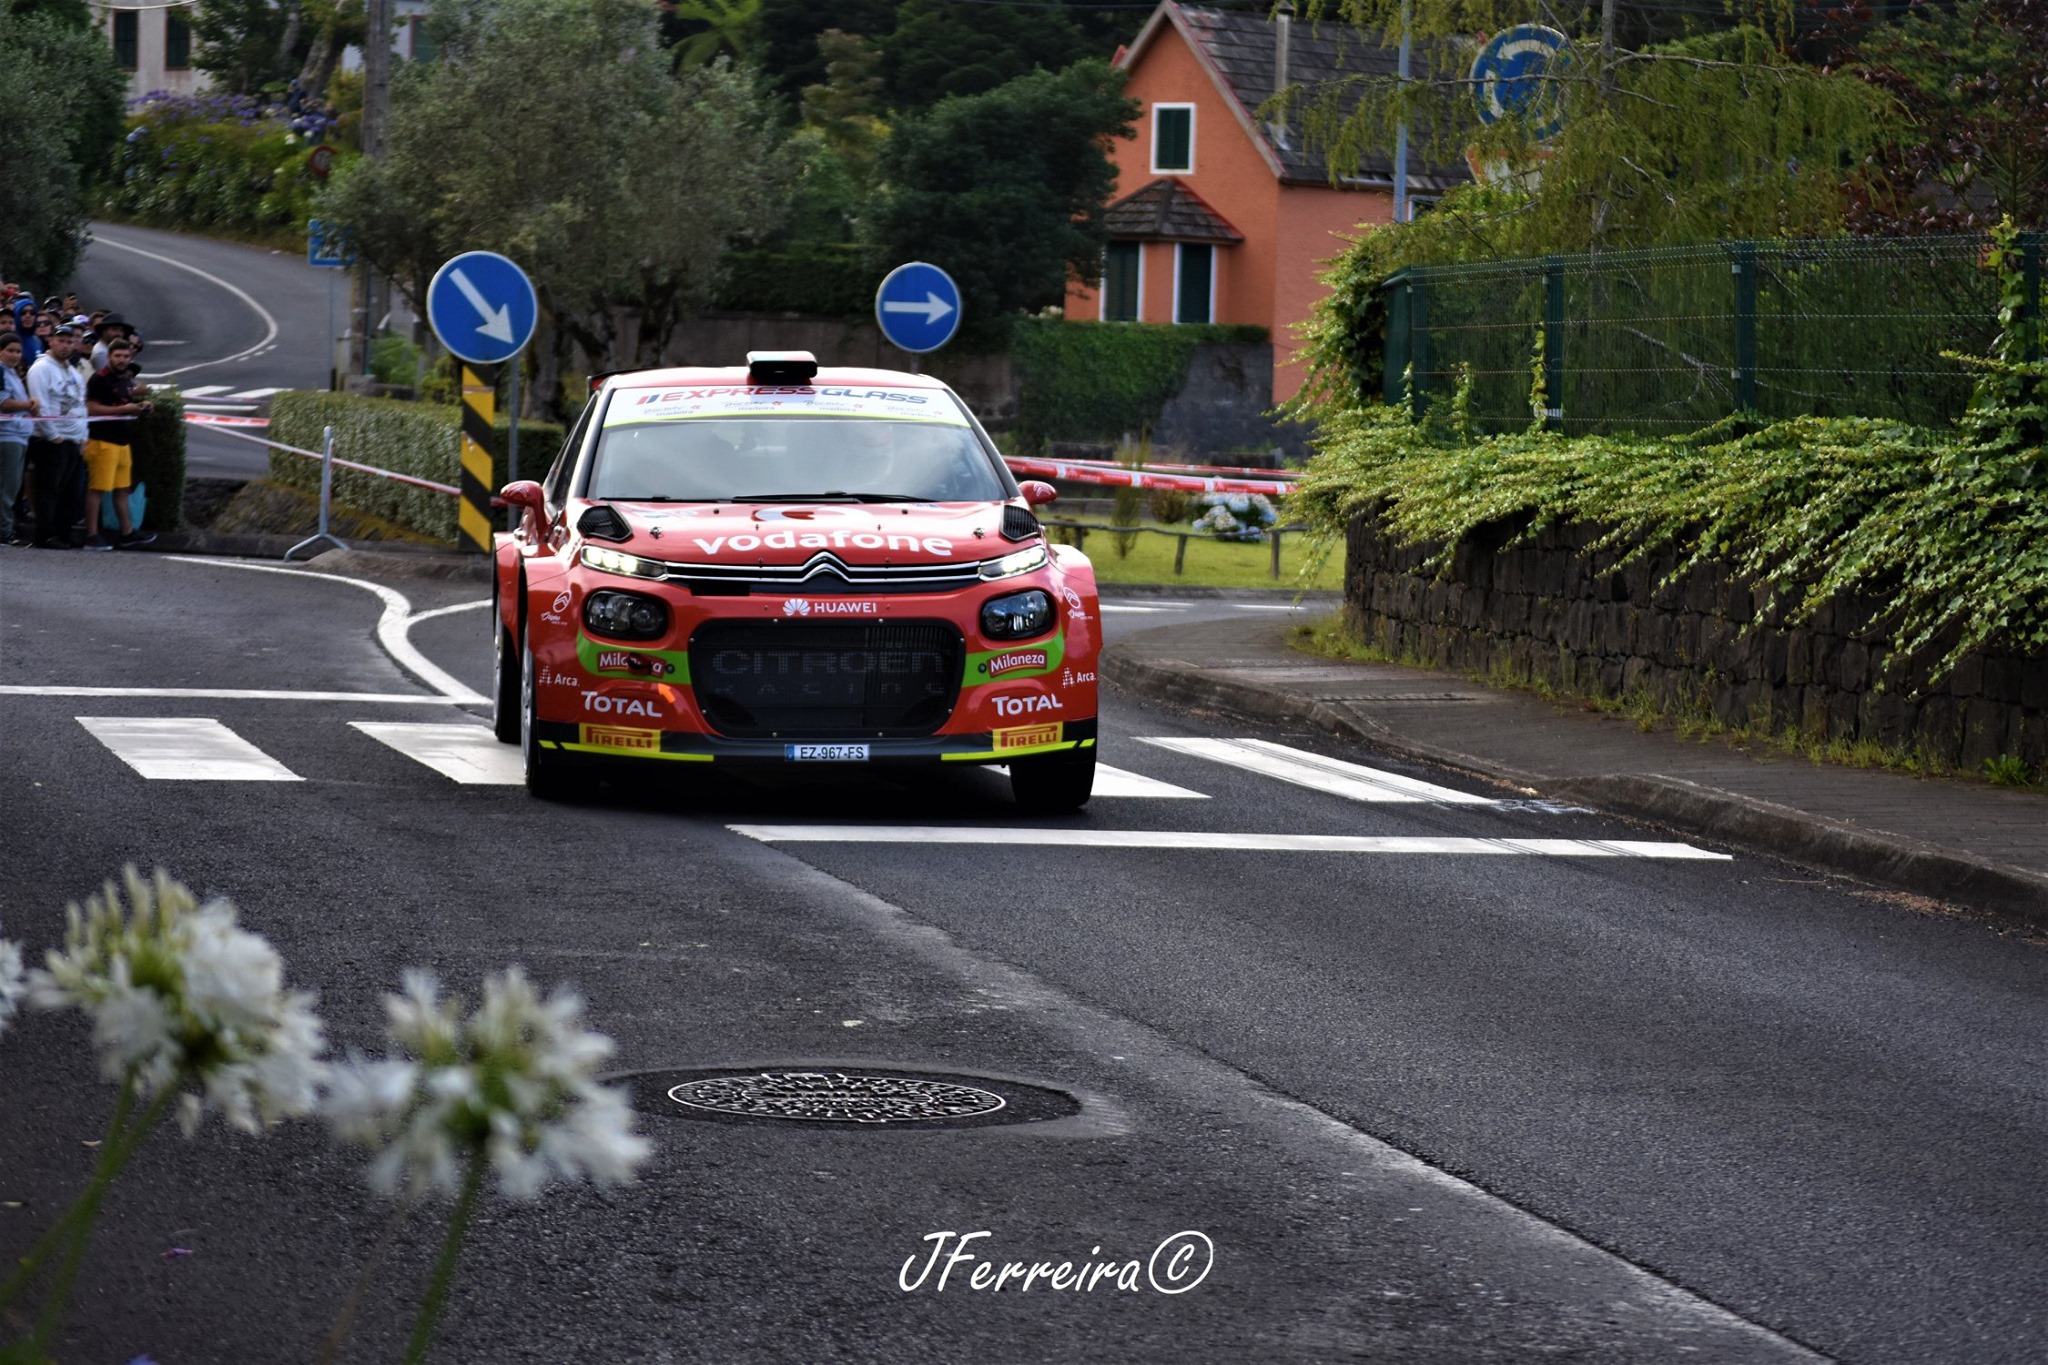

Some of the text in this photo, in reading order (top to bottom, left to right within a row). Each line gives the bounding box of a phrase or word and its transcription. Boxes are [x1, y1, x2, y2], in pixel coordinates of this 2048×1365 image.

[692, 530, 953, 556] vodafone
[814, 602, 877, 614] HUAWEI
[990, 654, 1046, 673] Milaneza
[581, 690, 663, 718] TOTAL
[991, 693, 1064, 717] TOTAL
[585, 725, 654, 749] PIRELLI
[1000, 724, 1058, 748] PIRELLI
[799, 747, 865, 760] EZ-967-FS
